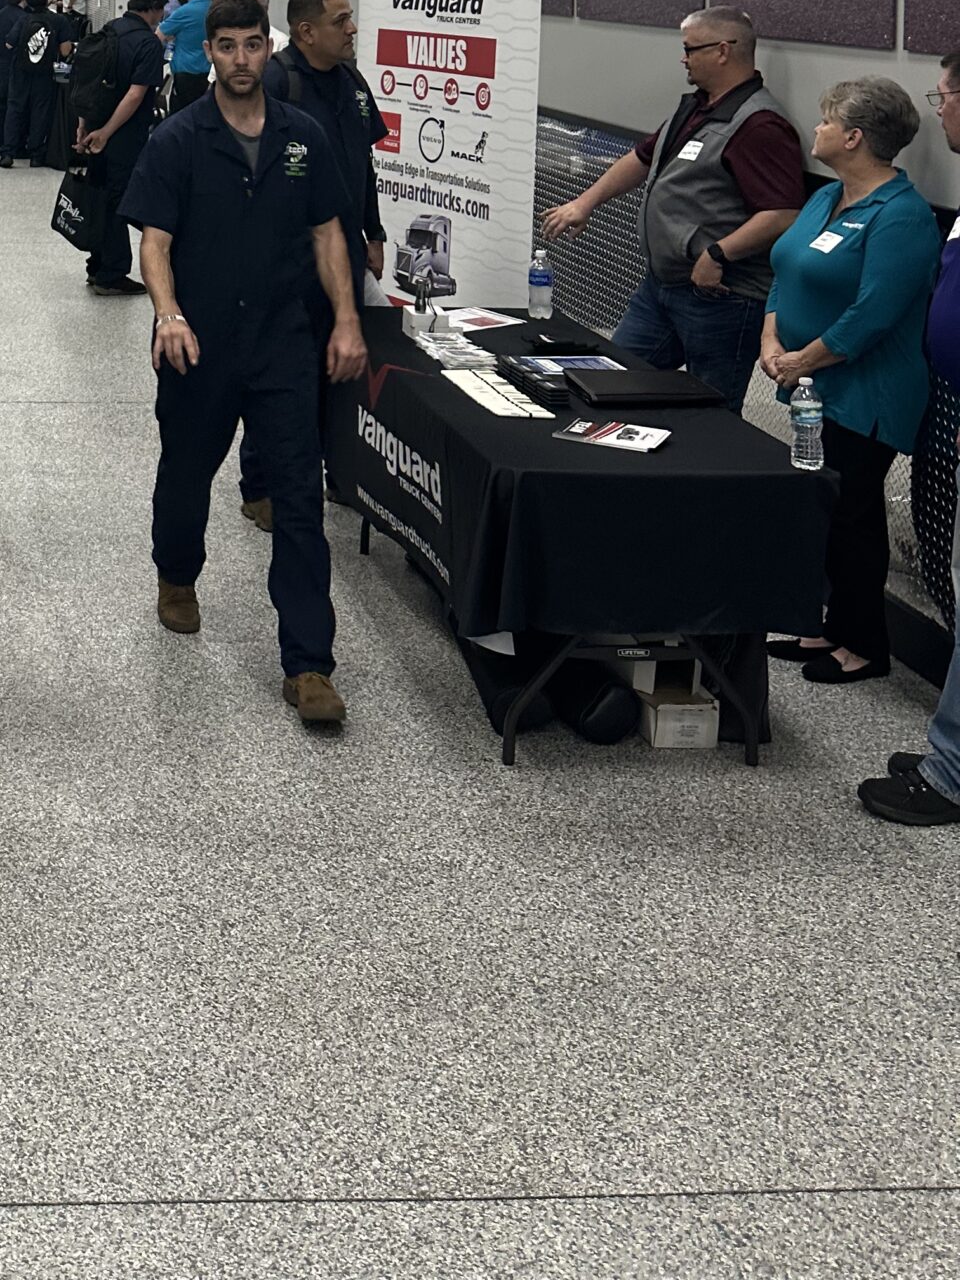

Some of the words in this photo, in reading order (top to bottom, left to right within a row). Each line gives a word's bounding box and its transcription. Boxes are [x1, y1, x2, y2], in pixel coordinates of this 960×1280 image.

[436, 15, 453, 24] TRUCK
[455, 16, 481, 26] CENTERS
[406, 35, 467, 72] VALUES
[421, 135, 442, 145] VOLVO
[450, 150, 484, 164] MACK
[381, 158, 404, 176] Leading
[404, 162, 419, 179] Edge
[419, 165, 426, 178] in
[425, 166, 464, 188] Transportation
[464, 175, 491, 194] Solutions
[357, 404, 442, 506] vanguard
[398, 475, 421, 501] TRUCK
[356, 483, 450, 587] www.vanguardtrucks.com
